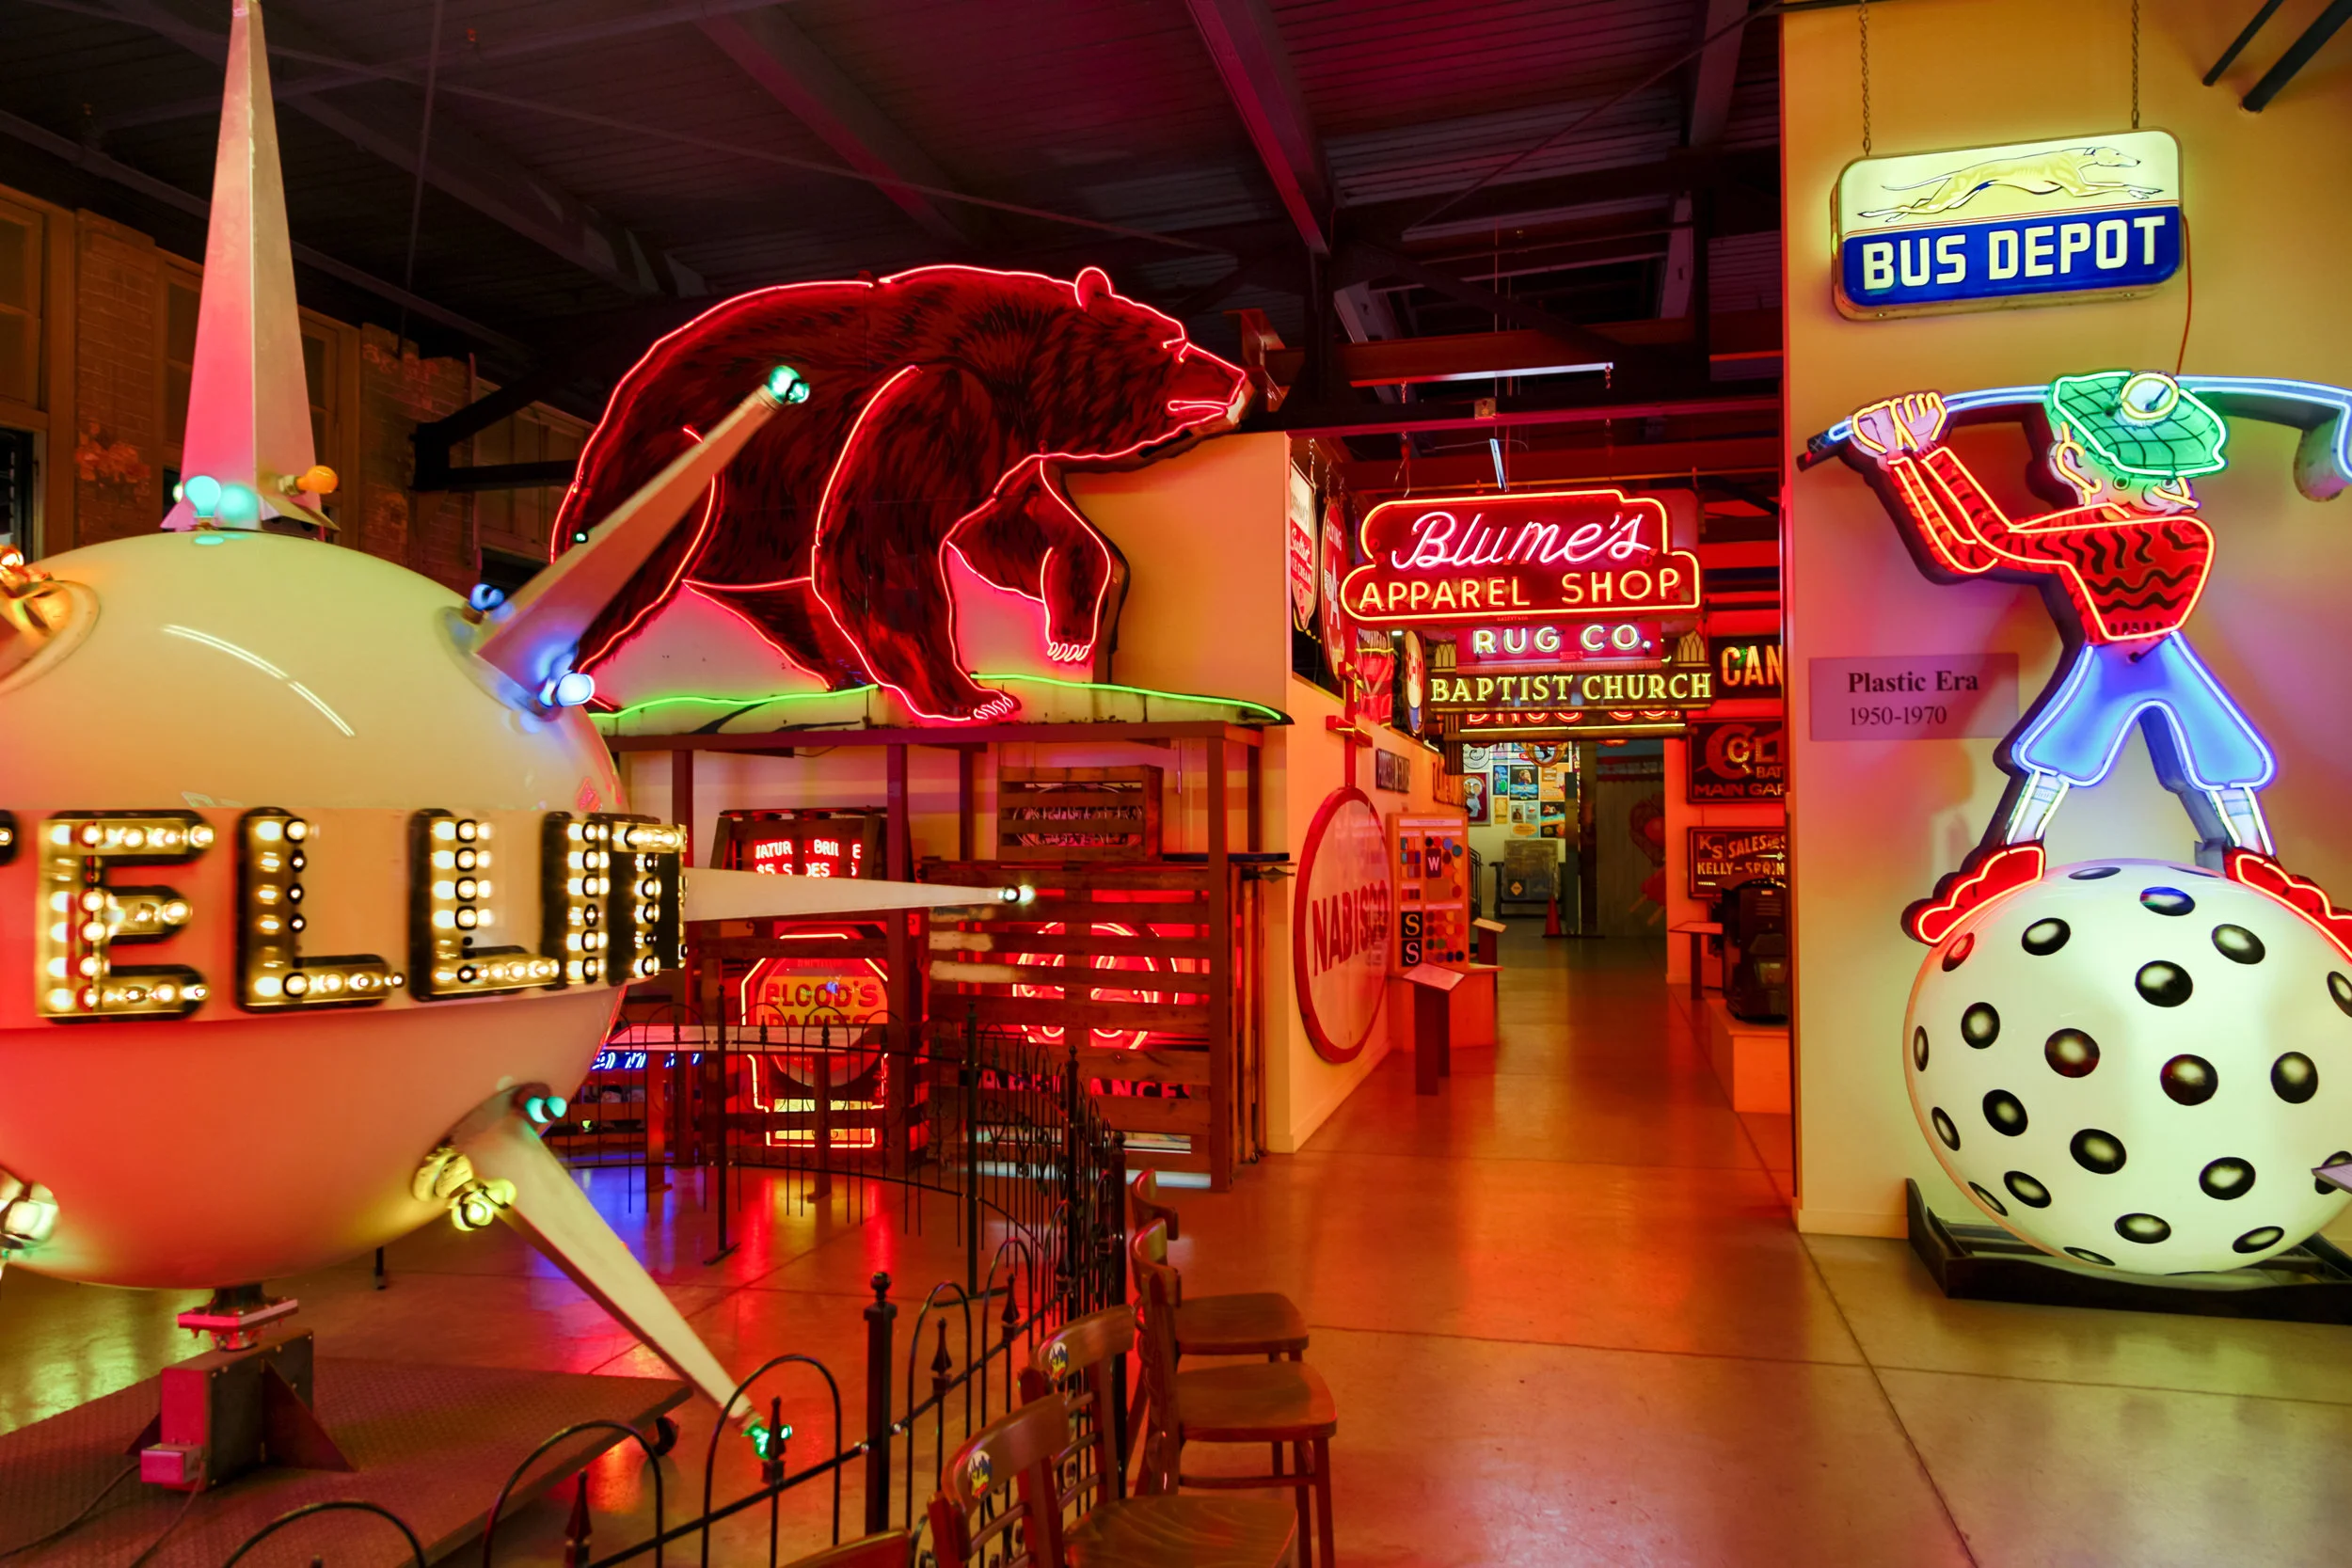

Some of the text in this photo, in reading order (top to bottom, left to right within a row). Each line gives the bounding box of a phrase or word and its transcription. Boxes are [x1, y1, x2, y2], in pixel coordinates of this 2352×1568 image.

[1862, 214, 2166, 292] BUS DEPOT
[1391, 511, 1652, 569] Blume's
[1359, 567, 1680, 613] APPAREL SHOP
[1472, 623, 1652, 656] RUG CO.
[1429, 672, 1712, 704] BAPTIST CHURCH
[1848, 670, 1979, 693] Plastic Era
[1850, 705, 1947, 726] 1950-1970
[1693, 783, 1744, 797] MAIN
[1727, 834, 1768, 859] SALES
[1427, 856, 1440, 872] W
[1312, 879, 1389, 977] NABISCO
[1405, 913, 1421, 936] S
[1405, 941, 1421, 965] S
[764, 980, 880, 1008] BLOOD'S
